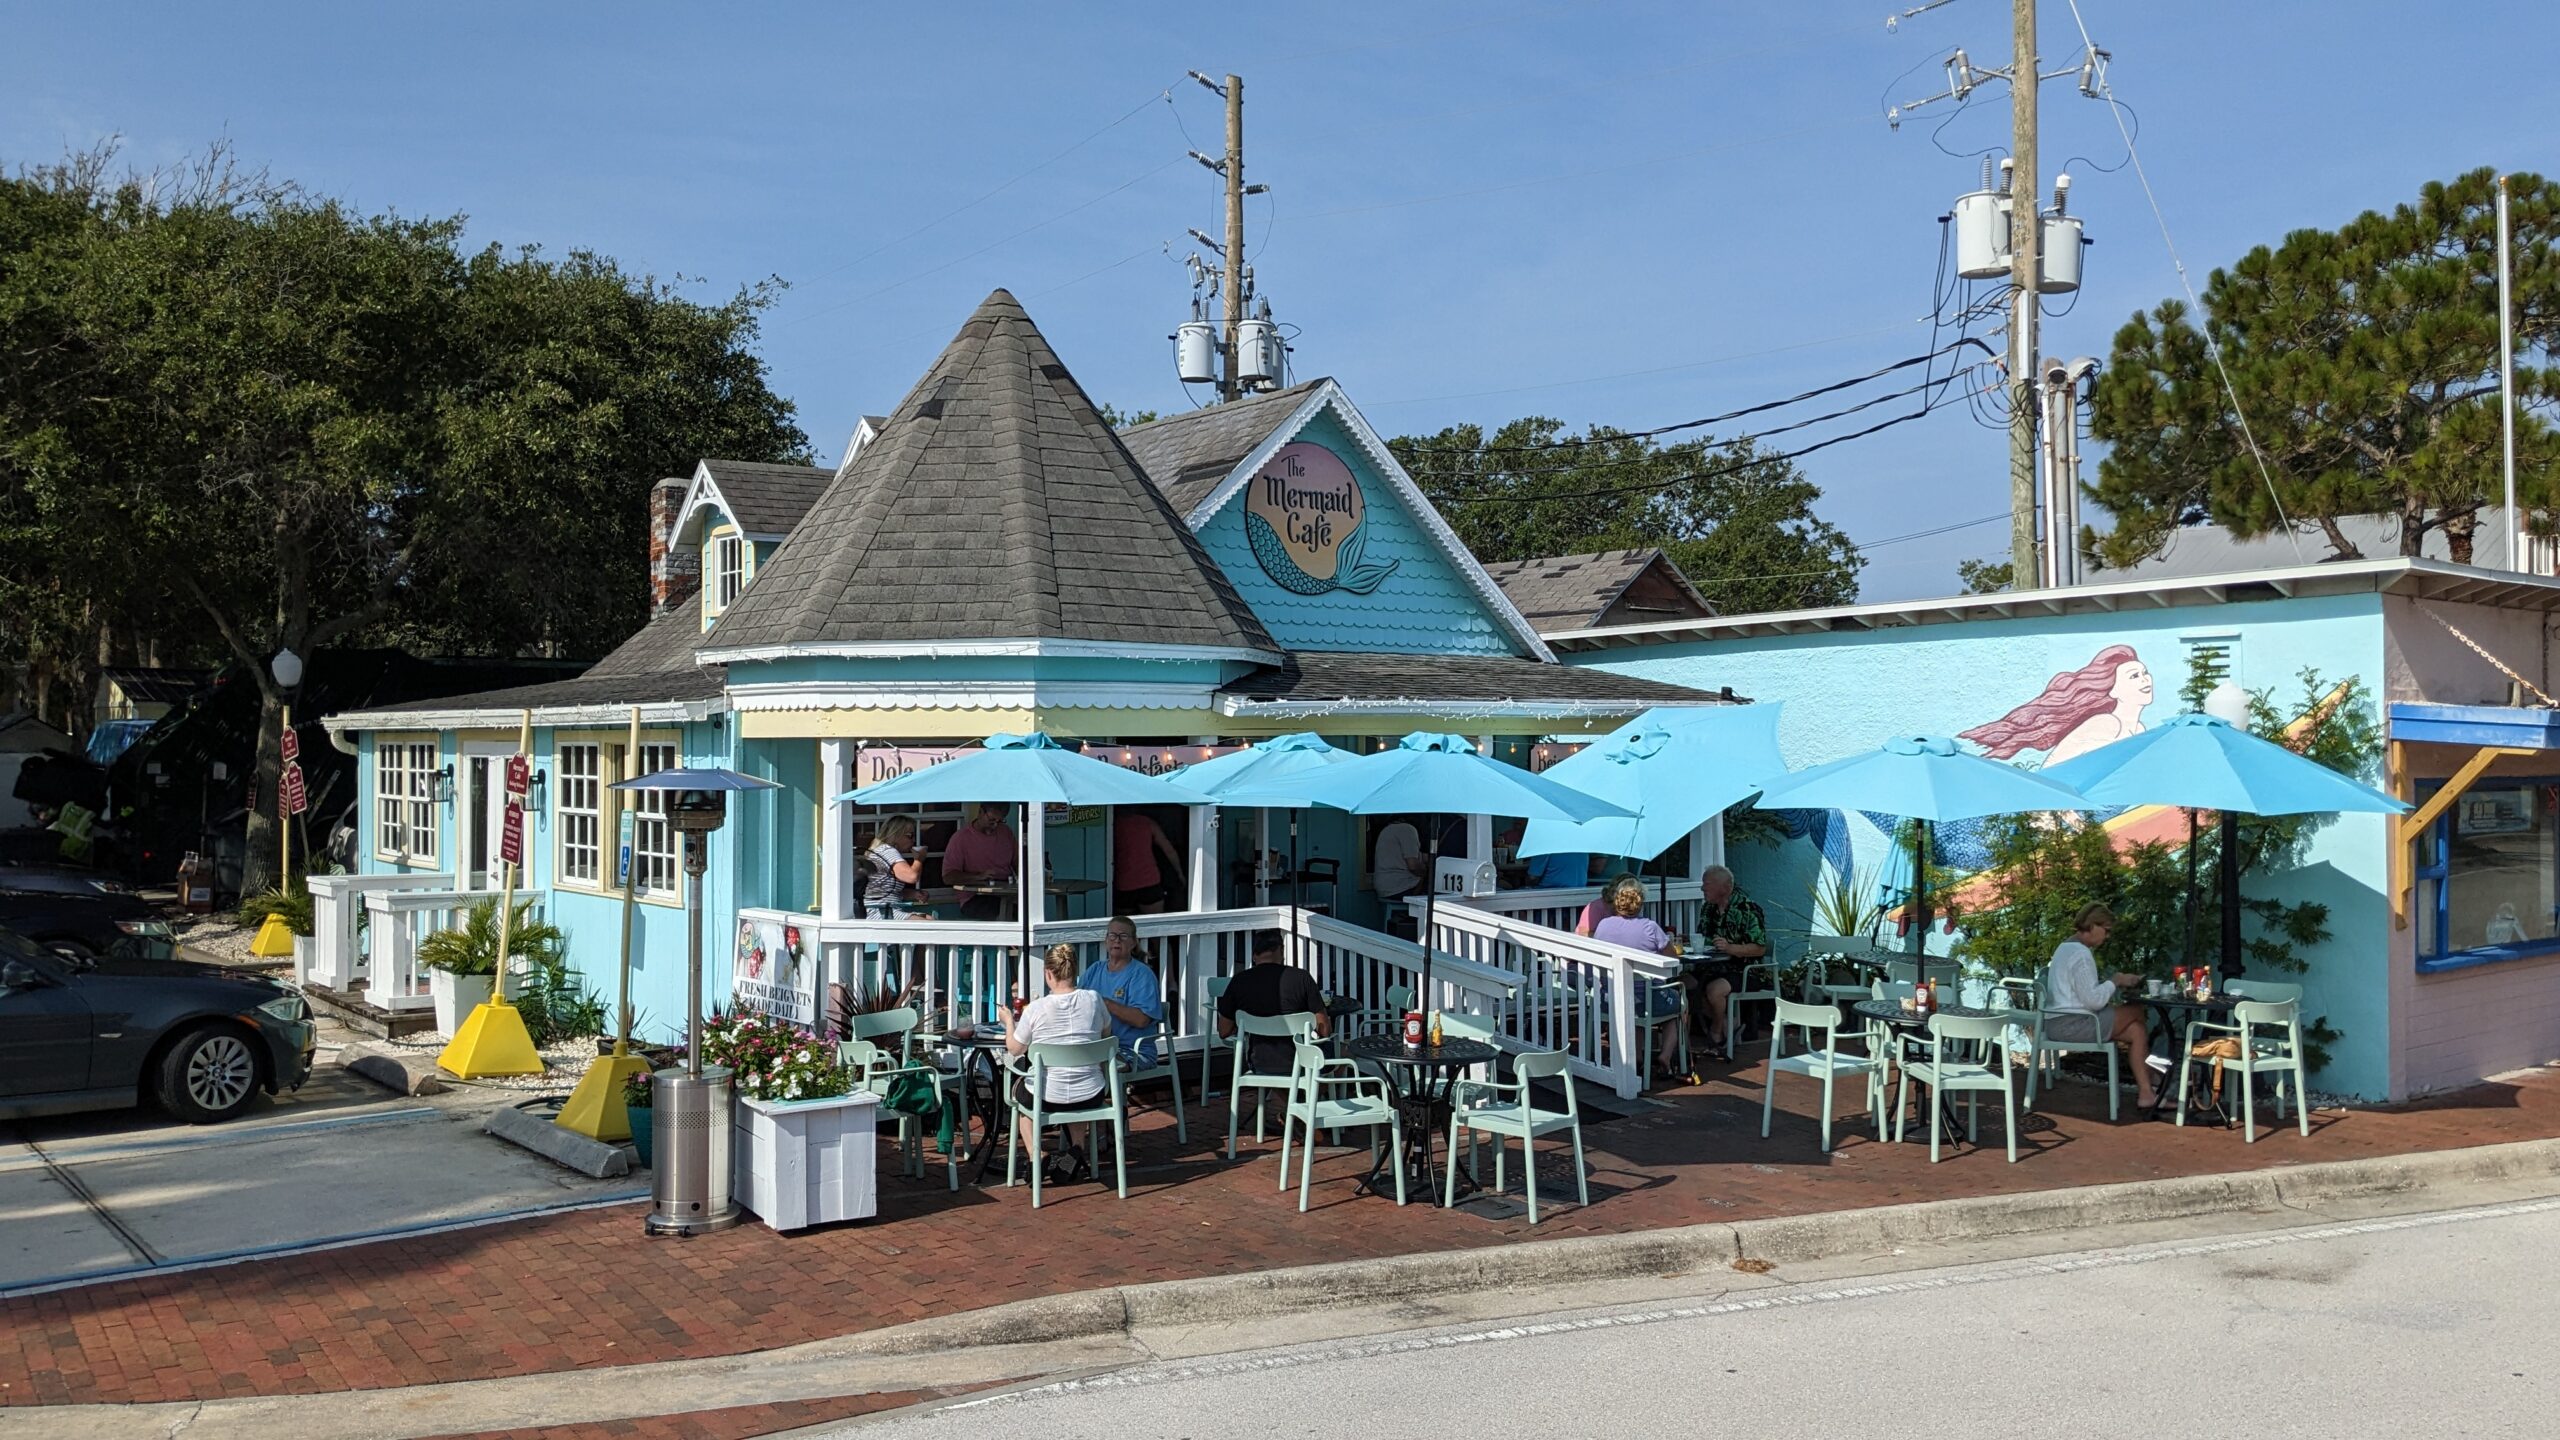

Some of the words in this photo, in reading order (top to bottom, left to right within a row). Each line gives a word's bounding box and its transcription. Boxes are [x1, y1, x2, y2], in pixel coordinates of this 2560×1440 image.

[1281, 454, 1305, 478] The
[1263, 475, 1354, 519] Mermaid
[1443, 873, 1463, 892] 113
[739, 980, 767, 998] FRESH
[769, 986, 812, 1008] BEIGNETS
[774, 1001, 800, 1020] DAILY
